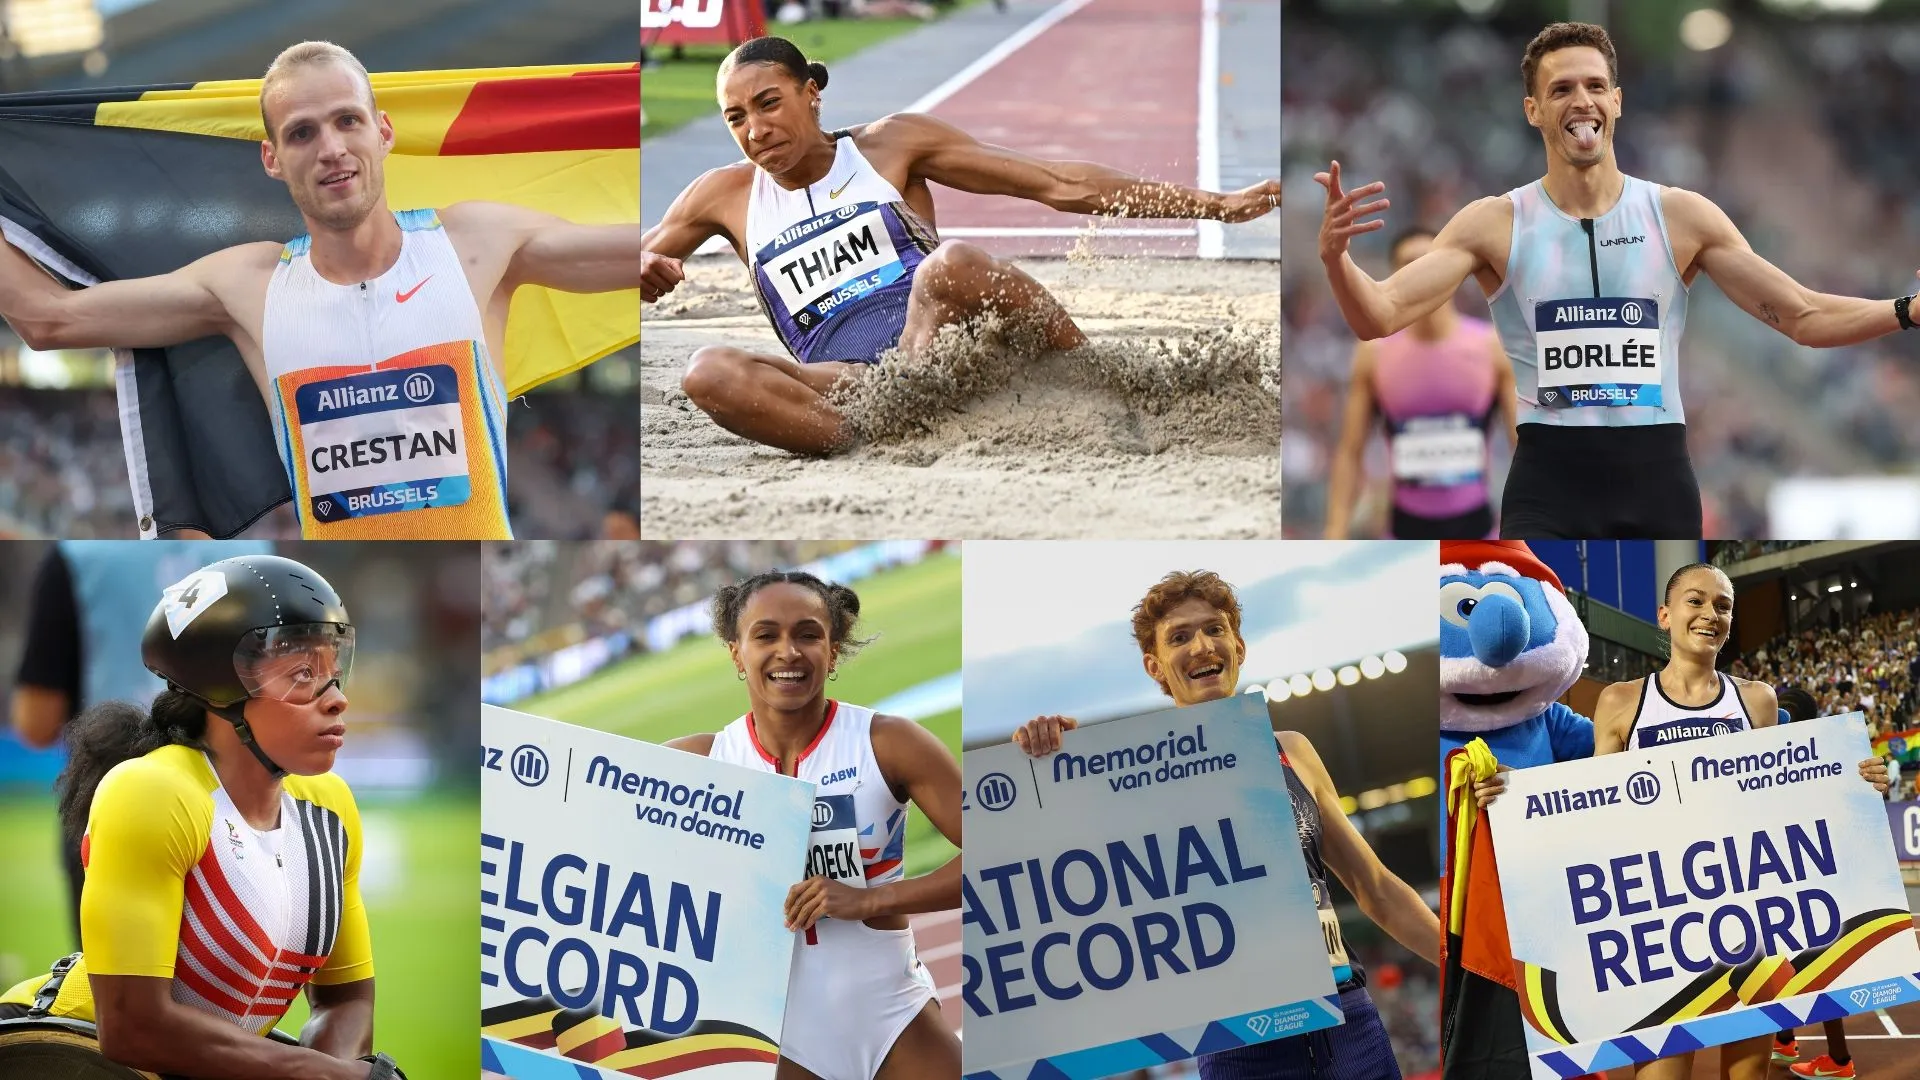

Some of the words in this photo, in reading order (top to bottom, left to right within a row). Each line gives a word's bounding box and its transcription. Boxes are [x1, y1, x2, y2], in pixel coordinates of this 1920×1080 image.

[773, 214, 833, 250] Allianz
[780, 225, 879, 294] THIAM
[817, 274, 881, 314] BRUSSELS
[1555, 305, 1617, 323] Allianz
[1544, 339, 1655, 370] BORLÉE
[317, 383, 399, 412] Allianz
[1571, 388, 1638, 401] BRUSSELS
[311, 428, 457, 473] CRESTAN
[348, 485, 439, 511] BRUSSELS
[178, 578, 202, 608] 4
[1656, 725, 1710, 742] Allianz
[1053, 724, 1207, 783] Memorial
[1691, 737, 1819, 782] Memorial
[585, 755, 745, 820] Memorial
[821, 766, 857, 786] CABW
[1108, 771, 1151, 792] van
[1155, 753, 1237, 783] damme
[1737, 774, 1772, 792] van
[1775, 761, 1843, 786] damme
[1525, 784, 1621, 819] Allianz
[635, 803, 678, 829] van
[680, 811, 765, 850] damme
[1566, 819, 1837, 926] BELGIAN
[1587, 888, 1841, 993] RECORD
[1872, 994, 1897, 1005] LEAGUE
[1873, 986, 1902, 999] DIAMOND
[1274, 1011, 1310, 1026] DIAMOND
[1274, 1020, 1304, 1033] LEAGUE
